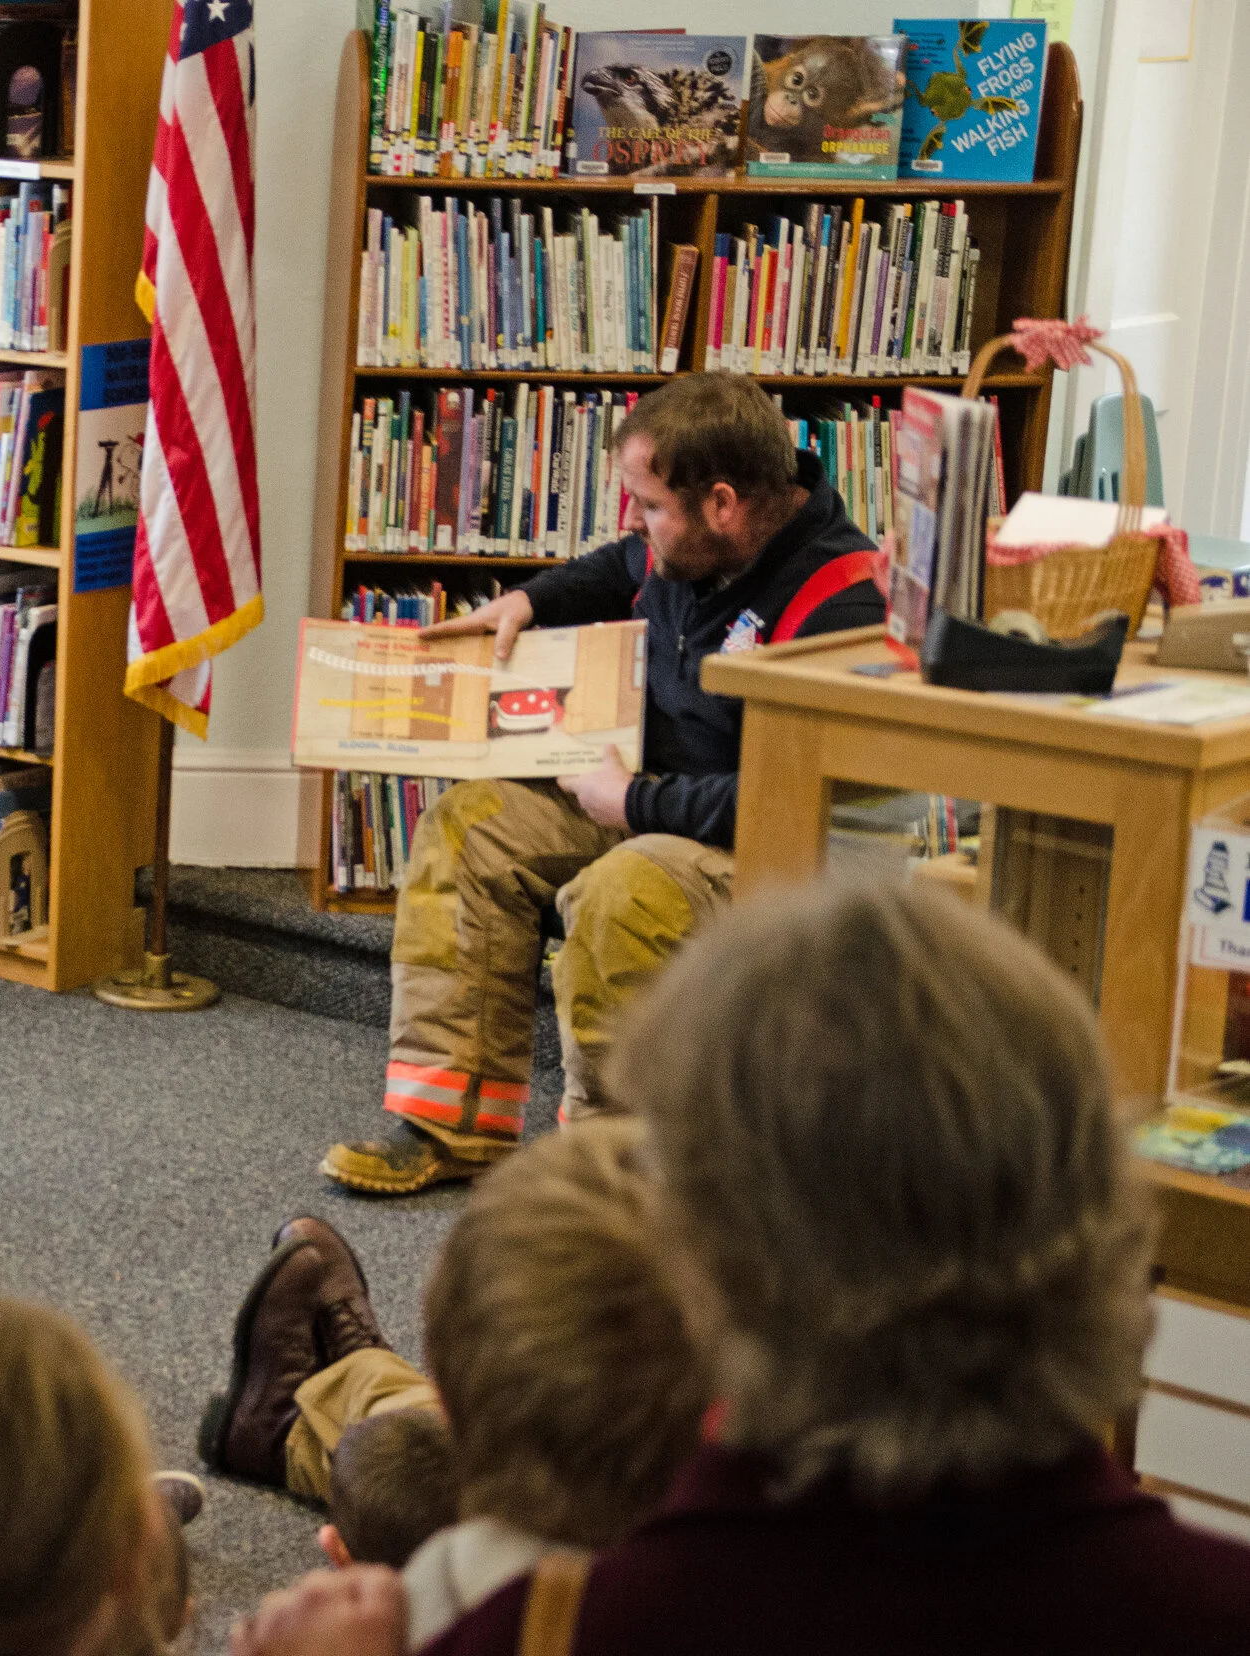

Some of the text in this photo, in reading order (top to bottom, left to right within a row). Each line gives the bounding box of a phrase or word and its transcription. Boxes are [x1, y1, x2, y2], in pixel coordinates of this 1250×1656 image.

[977, 32, 1037, 77] FLYING
[977, 57, 1035, 98] FROGS
[1011, 79, 1033, 98] AND
[599, 126, 625, 139] THE
[951, 100, 1031, 153] WALKING
[986, 122, 1029, 157] FISH
[592, 140, 707, 165] OSPREY
[821, 141, 891, 155] ORPHANAGE
[503, 447, 514, 474] GREAT
[551, 452, 562, 494] Our World
[501, 477, 512, 500] LIVES
